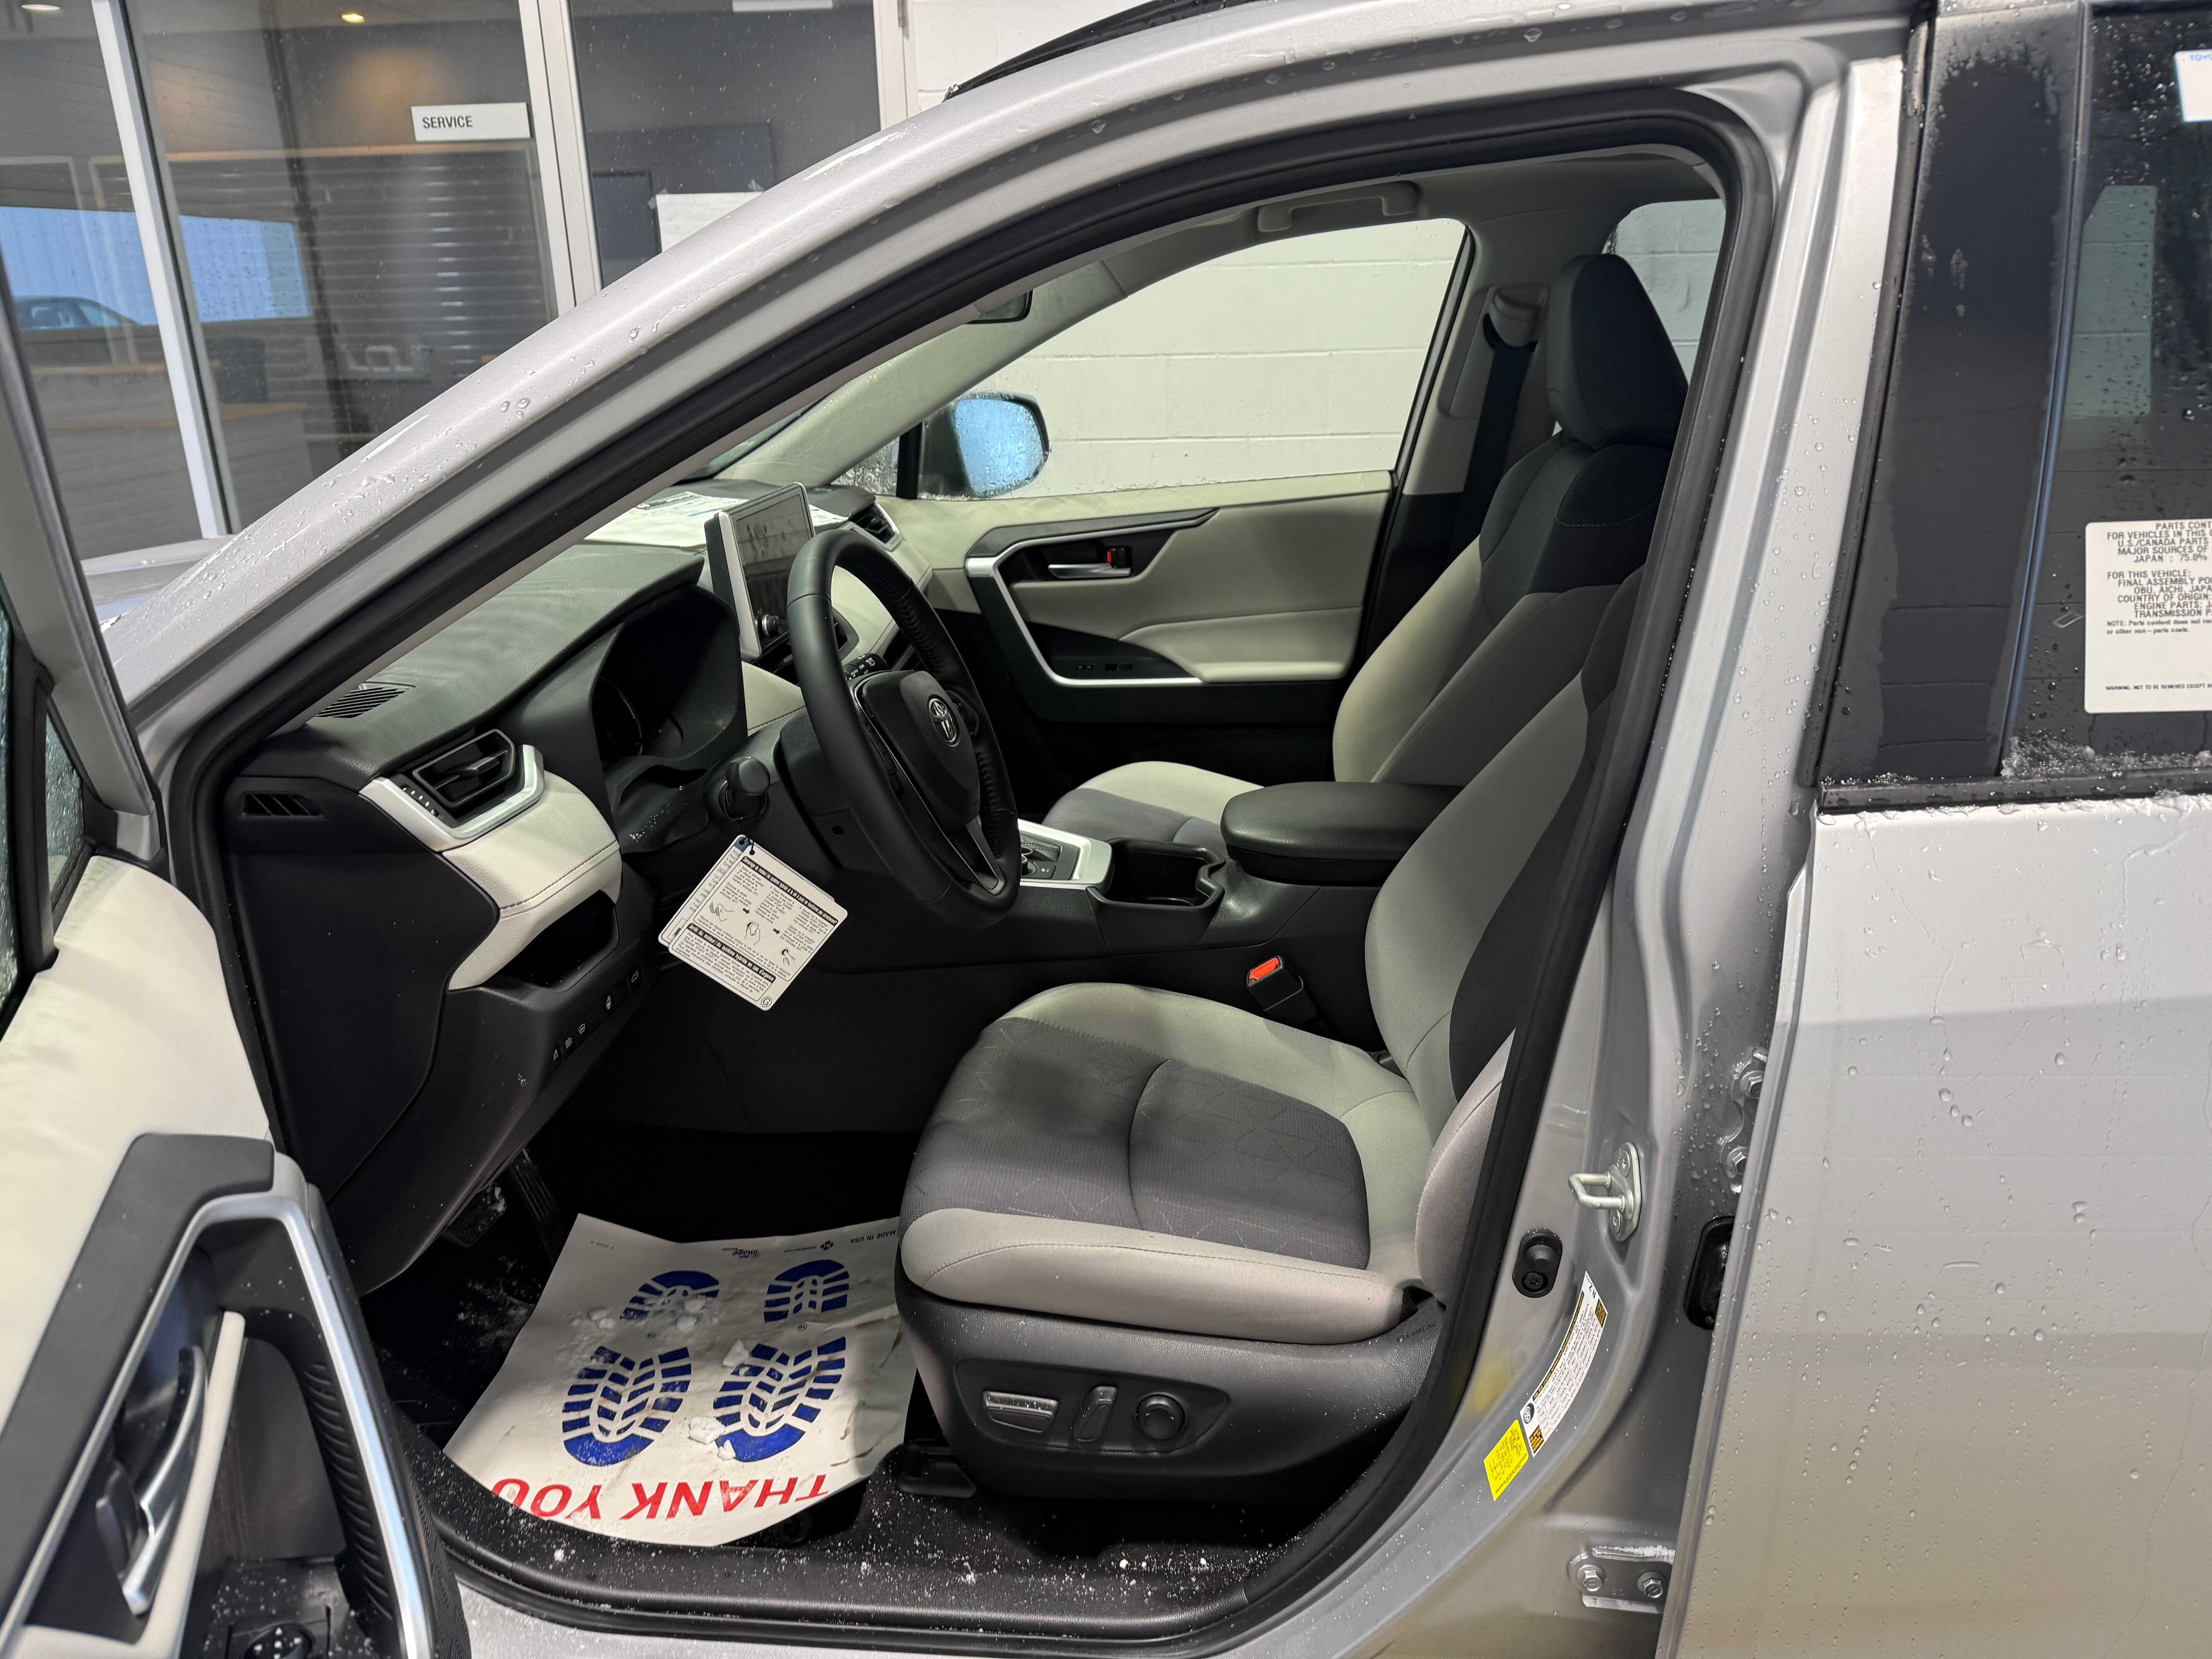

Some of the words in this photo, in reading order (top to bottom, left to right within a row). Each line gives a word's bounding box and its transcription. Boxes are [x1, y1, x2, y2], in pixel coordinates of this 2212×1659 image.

[422, 115, 473, 129] SERVICE
[2127, 531, 2169, 539] VEHICLES
[2118, 538, 2176, 547] U.S./CANADA
[2152, 546, 2193, 554] SOURCES
[2147, 577, 2195, 586] ASSEMBLY
[2118, 594, 2160, 603] COUNTRY
[2135, 609, 2202, 618] TRANSMISSION
[876, 1230, 896, 1239] MADE
[492, 1478, 603, 1520] YOU
[620, 1474, 830, 1519] THANK
